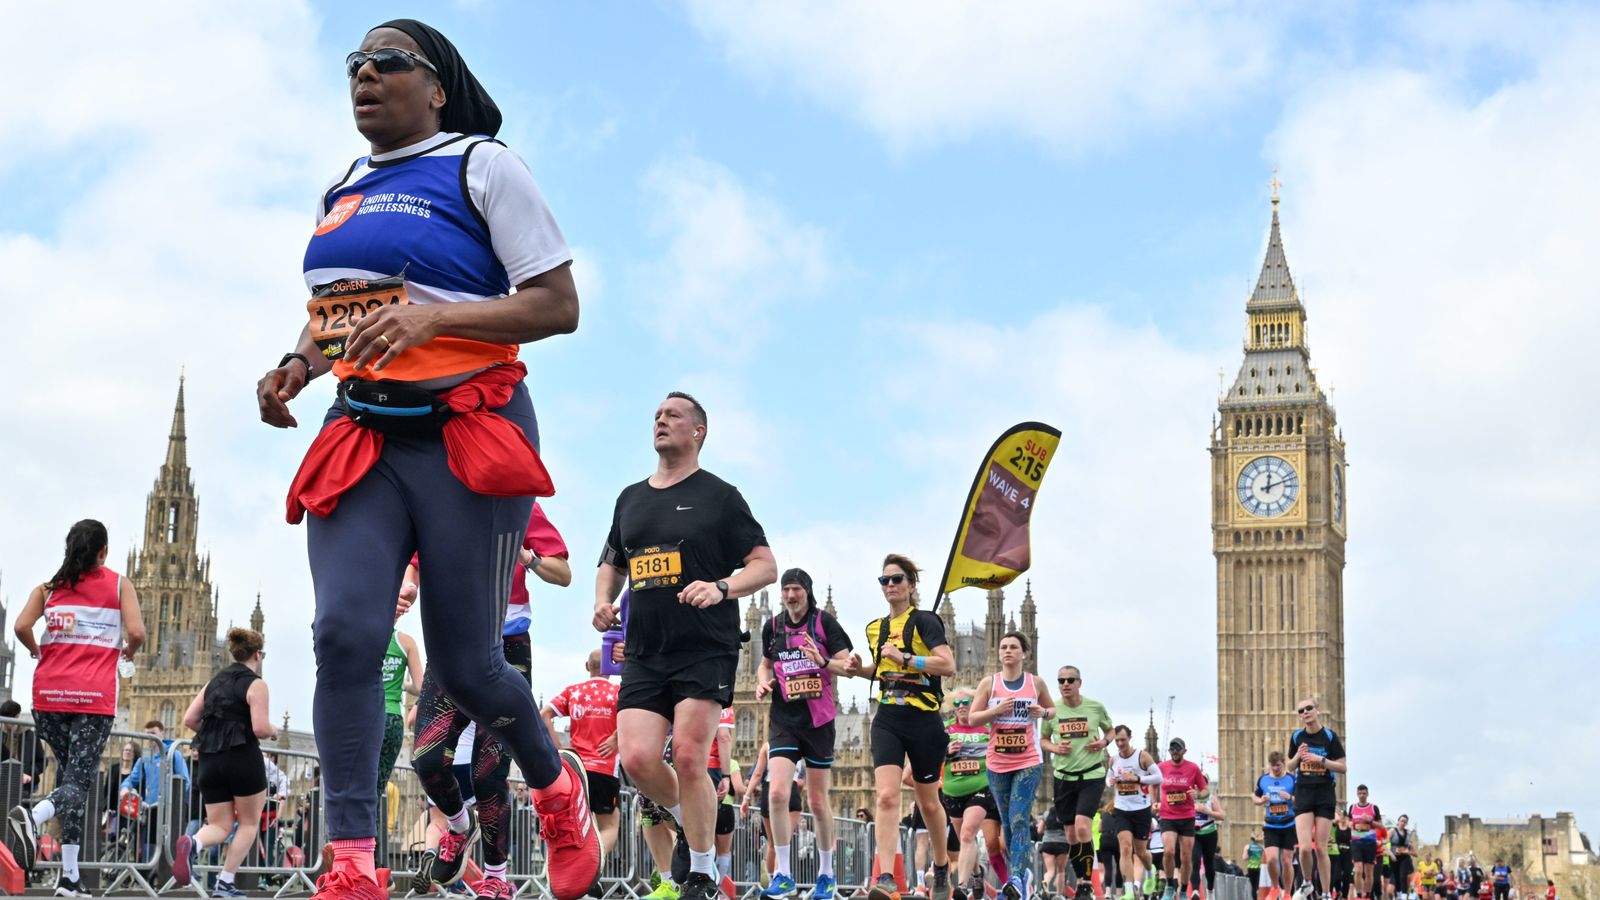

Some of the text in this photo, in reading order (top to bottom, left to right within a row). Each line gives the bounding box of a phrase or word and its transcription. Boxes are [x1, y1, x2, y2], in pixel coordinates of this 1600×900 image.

[362, 193, 431, 208] ENDING YOUTH
[357, 203, 431, 219] HOMELESSNESS
[332, 280, 369, 292] OGHENE
[316, 295, 400, 332] 120
[1025, 440, 1047, 460] SUB
[1009, 447, 1045, 482] 2:15
[988, 470, 1030, 509] WAVE 4
[636, 557, 670, 576] 5181
[382, 657, 403, 665] LAN
[778, 650, 800, 660] YOUNG
[788, 680, 820, 692] 10165
[1060, 722, 1087, 732] 11637
[996, 735, 1026, 745] 11676
[952, 761, 978, 770] 11318
